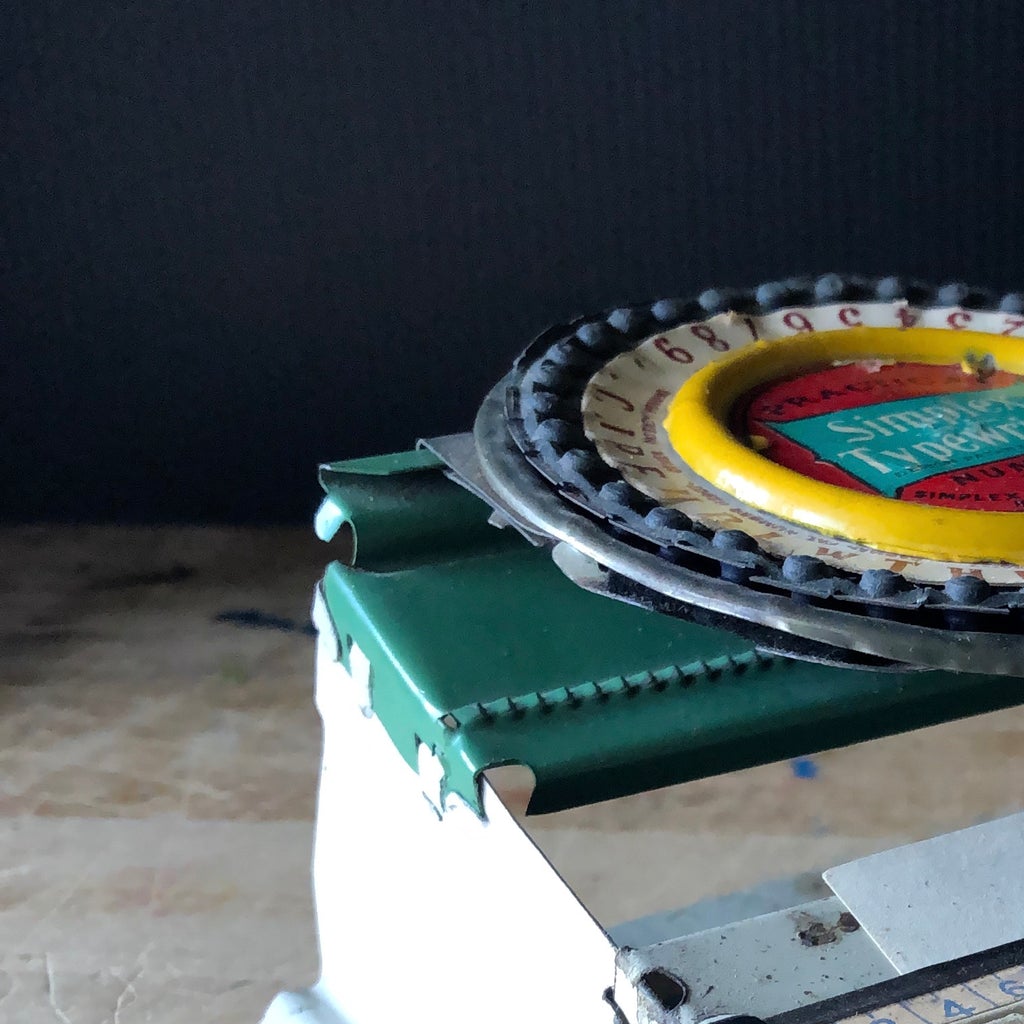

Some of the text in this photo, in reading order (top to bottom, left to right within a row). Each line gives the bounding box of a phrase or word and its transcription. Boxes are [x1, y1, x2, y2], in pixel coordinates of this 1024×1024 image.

[655, 338, 693, 364] 6
[690, 325, 730, 351] 8
[943, 998, 977, 1018] 4
